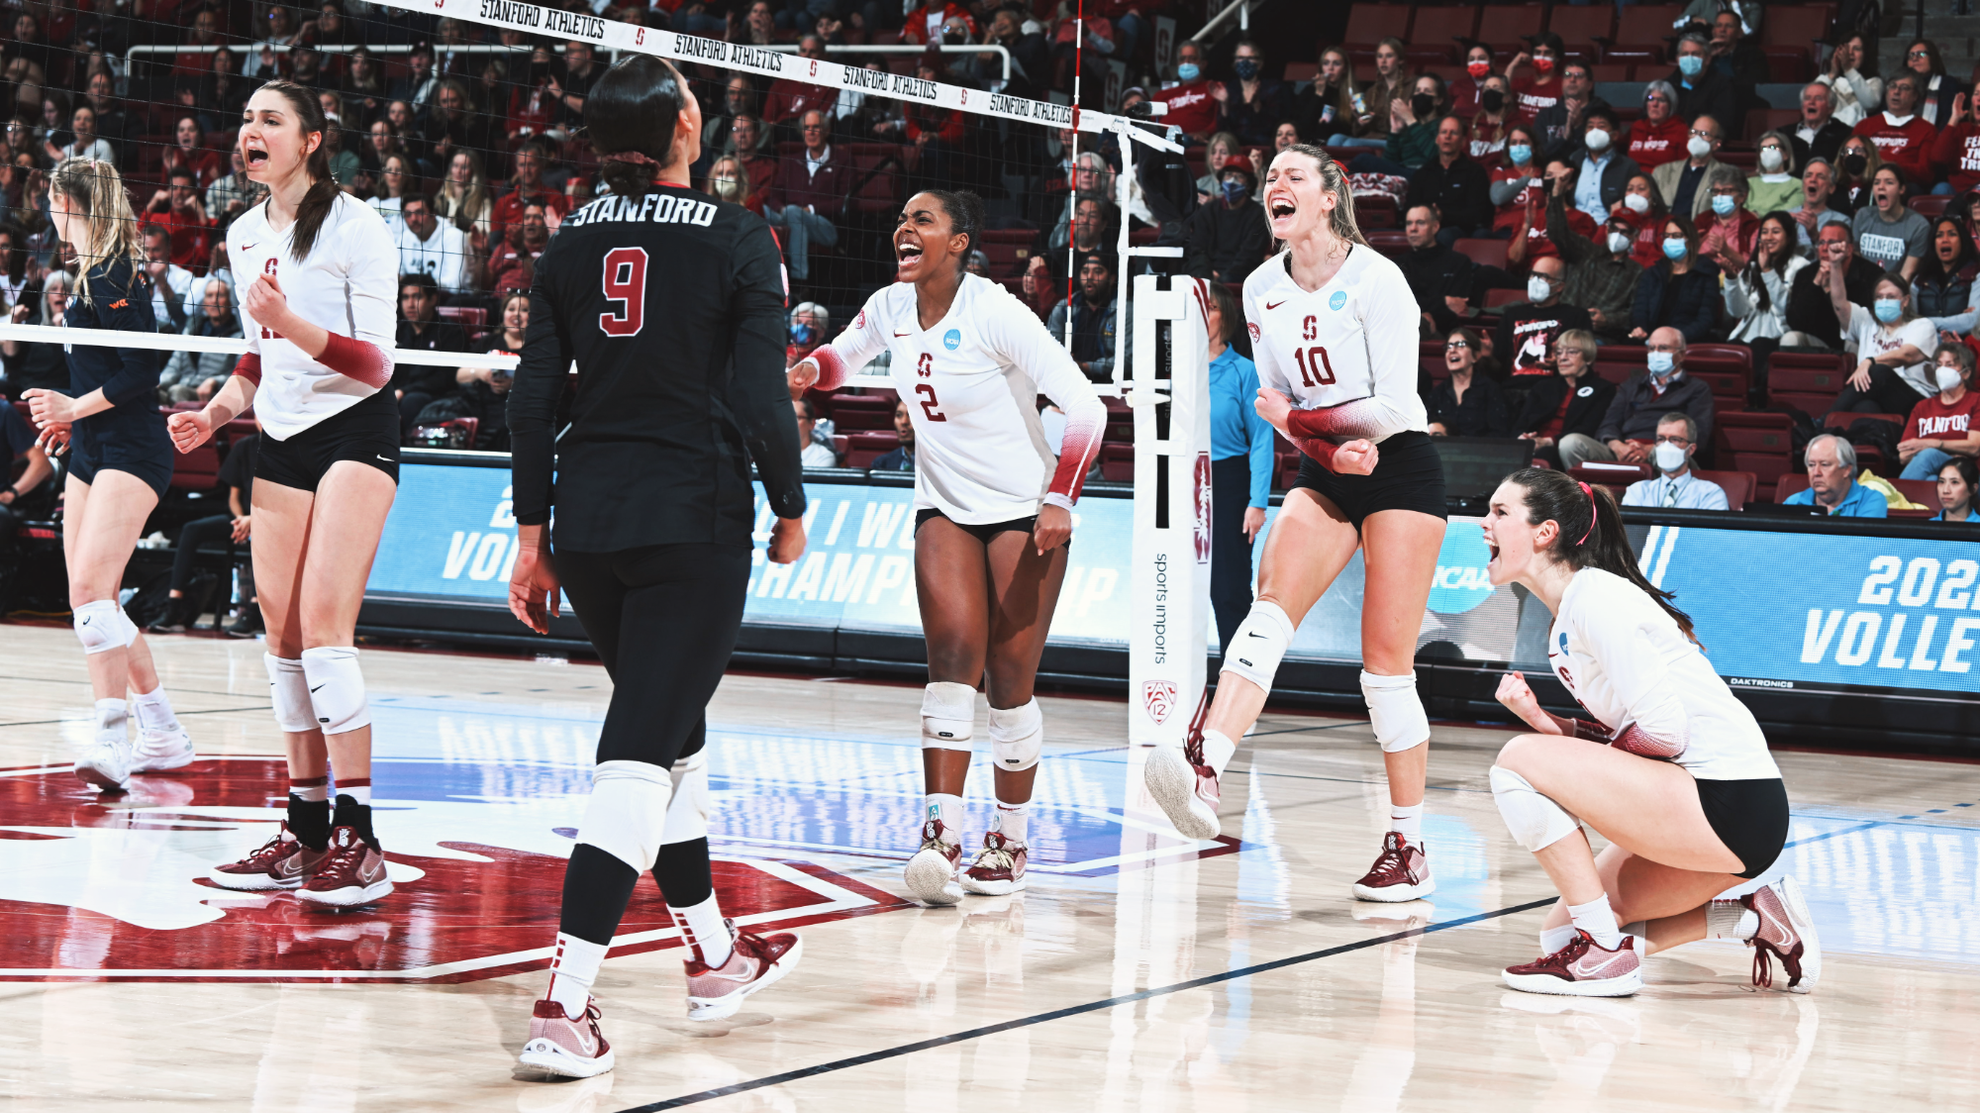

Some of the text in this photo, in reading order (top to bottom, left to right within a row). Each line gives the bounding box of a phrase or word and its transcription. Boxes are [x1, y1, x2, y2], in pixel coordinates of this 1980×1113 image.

[480, 0, 605, 39] STANFORD ATHLETICS
[674, 34, 783, 72] STANFORD ATHLETICS
[843, 65, 937, 100] STANFORD ATHLETICS
[989, 94, 1071, 124] STANFORD ATHLETICS
[573, 193, 718, 227] STANFORD
[599, 246, 649, 337] 9
[1294, 346, 1336, 388] 10
[915, 383, 947, 422] 2
[1153, 553, 1168, 665] sports imports
[1730, 678, 1793, 688] DAKTRONICS
[1153, 704, 1166, 715] 12
